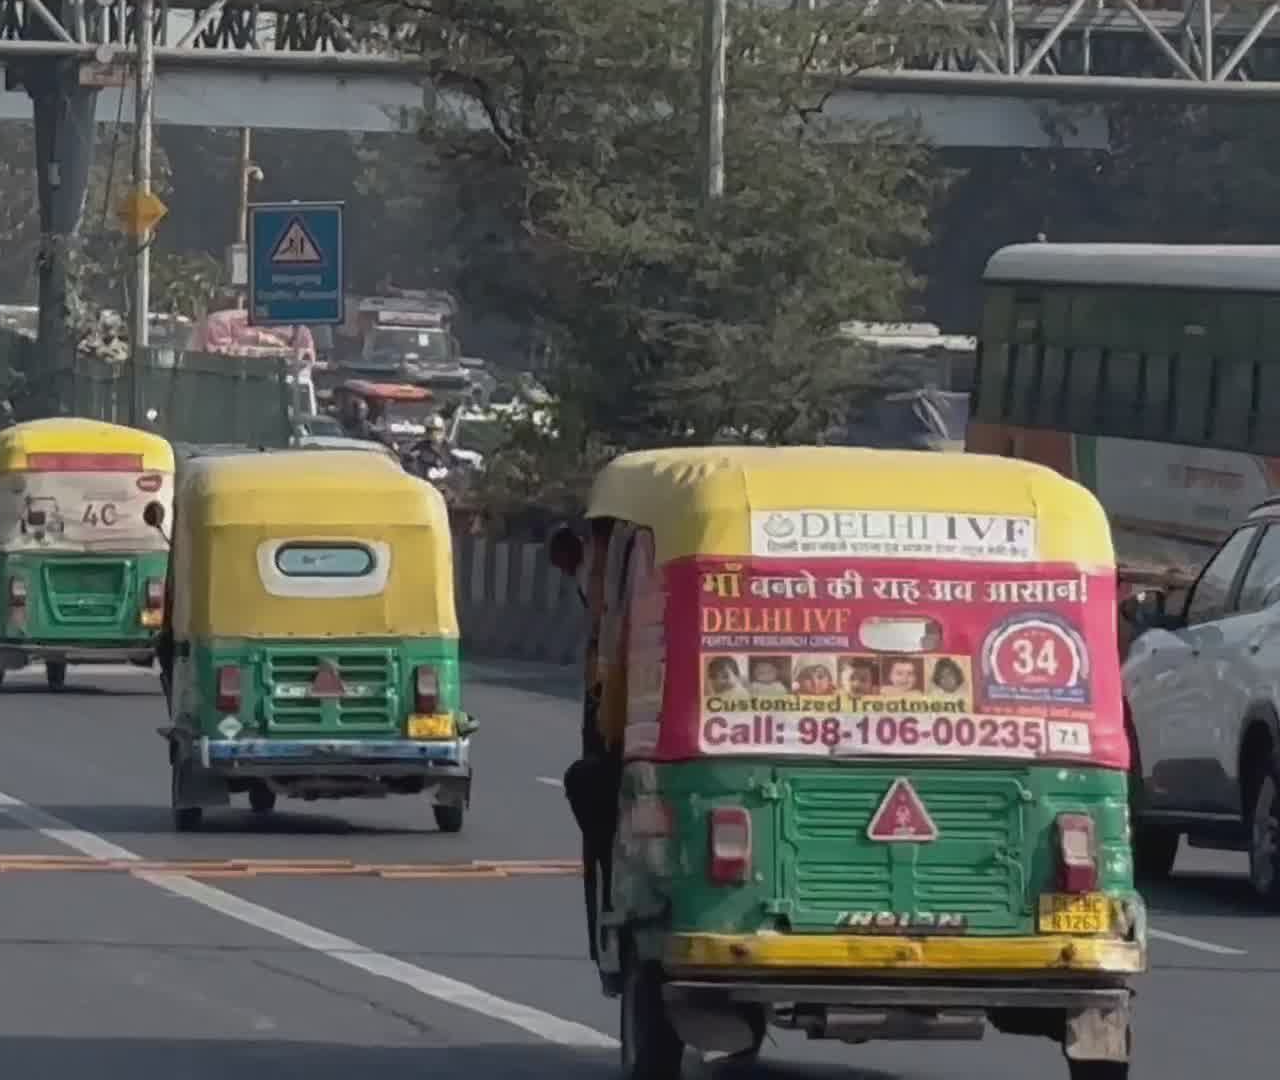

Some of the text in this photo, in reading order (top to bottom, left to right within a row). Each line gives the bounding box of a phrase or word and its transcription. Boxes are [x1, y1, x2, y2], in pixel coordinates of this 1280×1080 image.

[799, 512, 1031, 542] DELHI IVF
[750, 571, 817, 598] बनने
[827, 570, 863, 599] की
[873, 576, 920, 603] राह
[928, 578, 974, 602] अब
[702, 607, 851, 633] DELHI IVF
[1011, 639, 1058, 676] 34
[706, 696, 841, 713] Customized
[848, 696, 967, 713] Treatment
[703, 715, 1042, 750] Call: 98-106-00235
